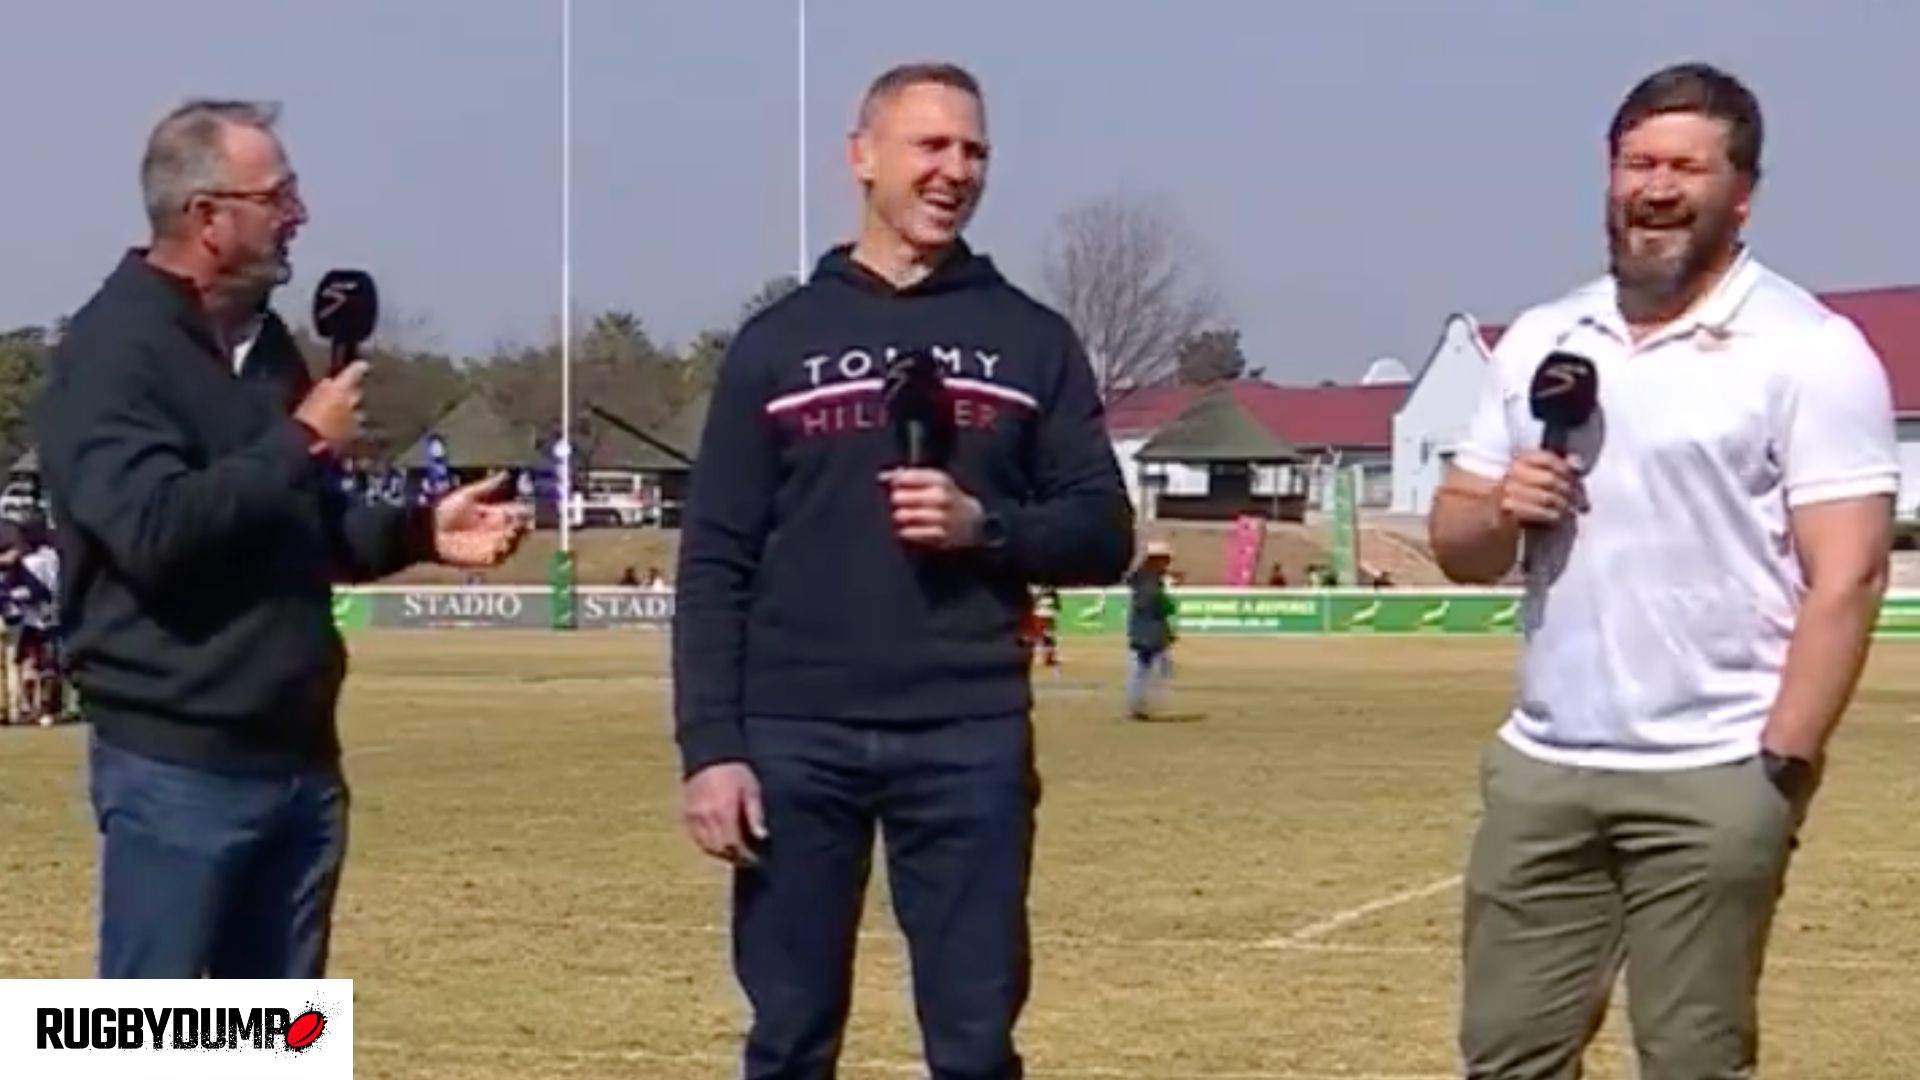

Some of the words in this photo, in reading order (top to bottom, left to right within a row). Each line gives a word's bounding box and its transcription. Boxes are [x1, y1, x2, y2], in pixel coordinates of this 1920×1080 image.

[803, 345, 1000, 385] TOMY
[802, 398, 998, 436] HILER
[401, 592, 522, 618] STADIO
